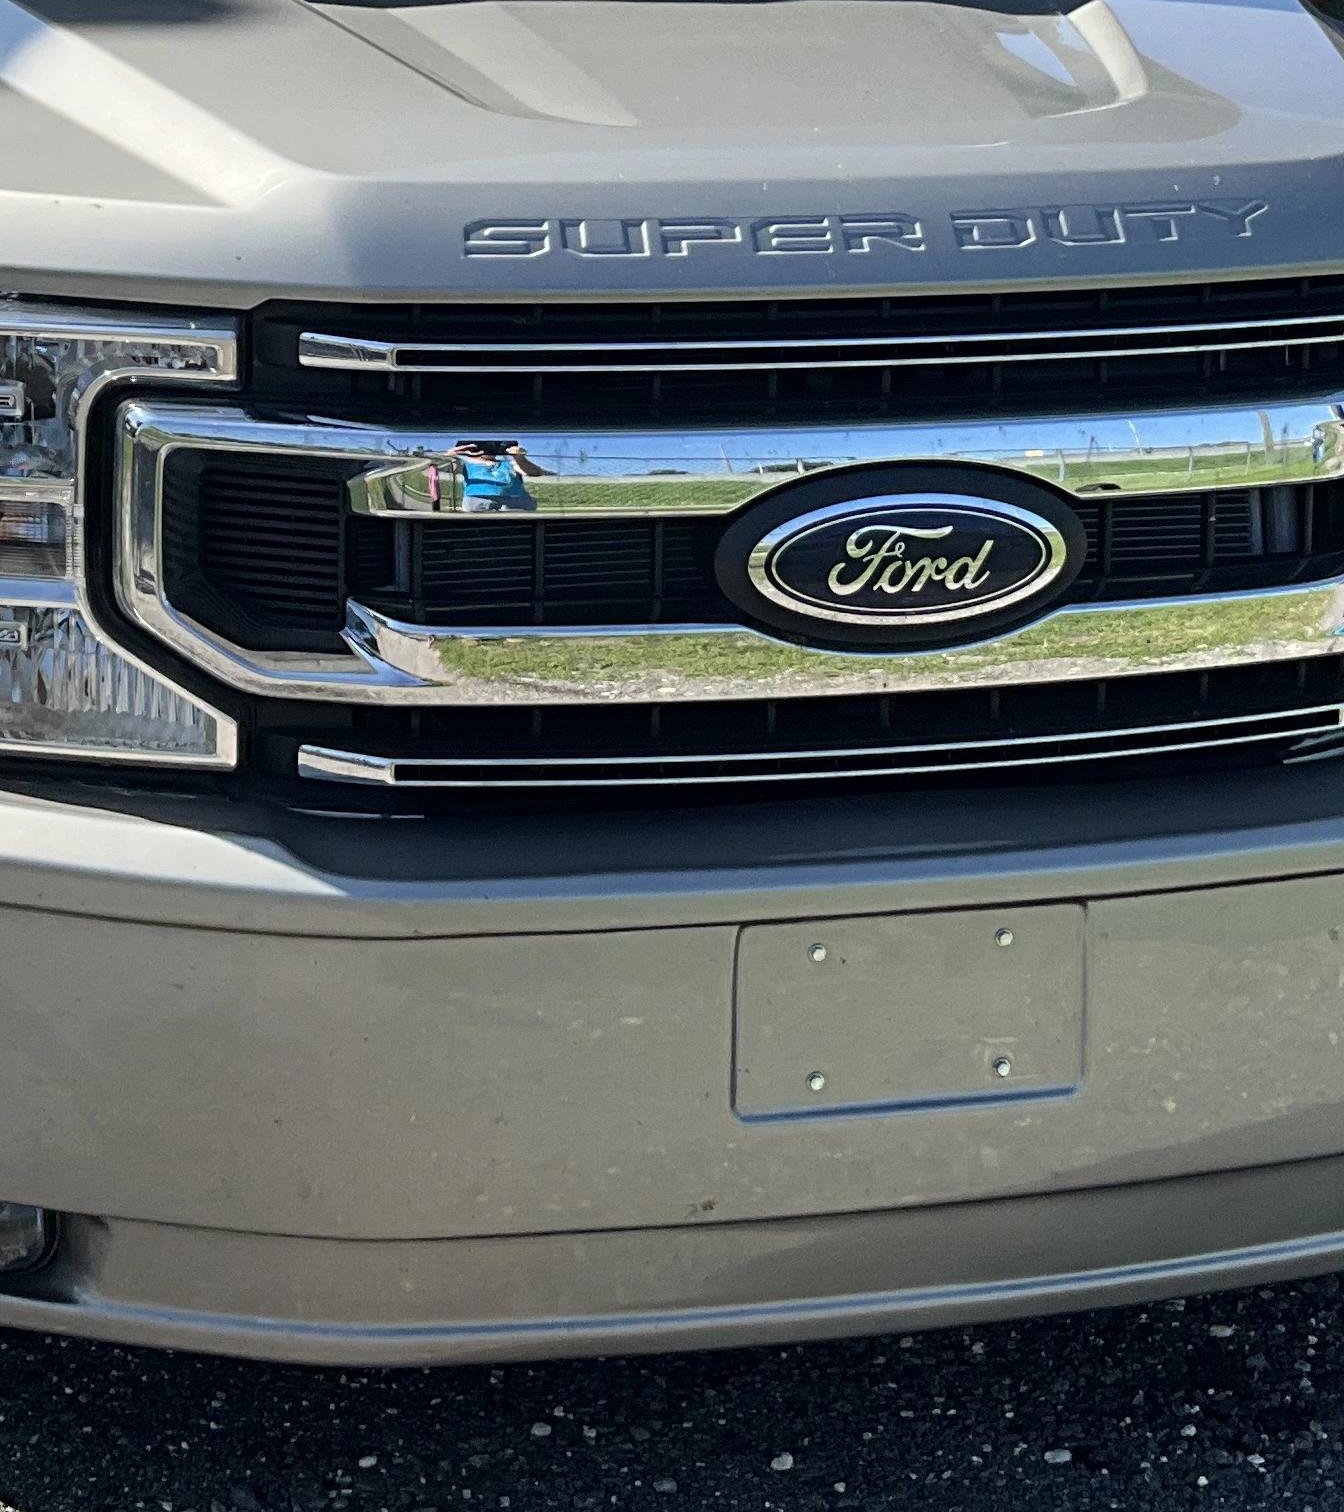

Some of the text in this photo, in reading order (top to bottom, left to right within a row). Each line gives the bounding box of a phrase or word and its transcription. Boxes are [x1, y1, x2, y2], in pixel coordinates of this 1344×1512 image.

[461, 197, 1270, 260] SUPER DUTY
[827, 524, 995, 596] Ford
